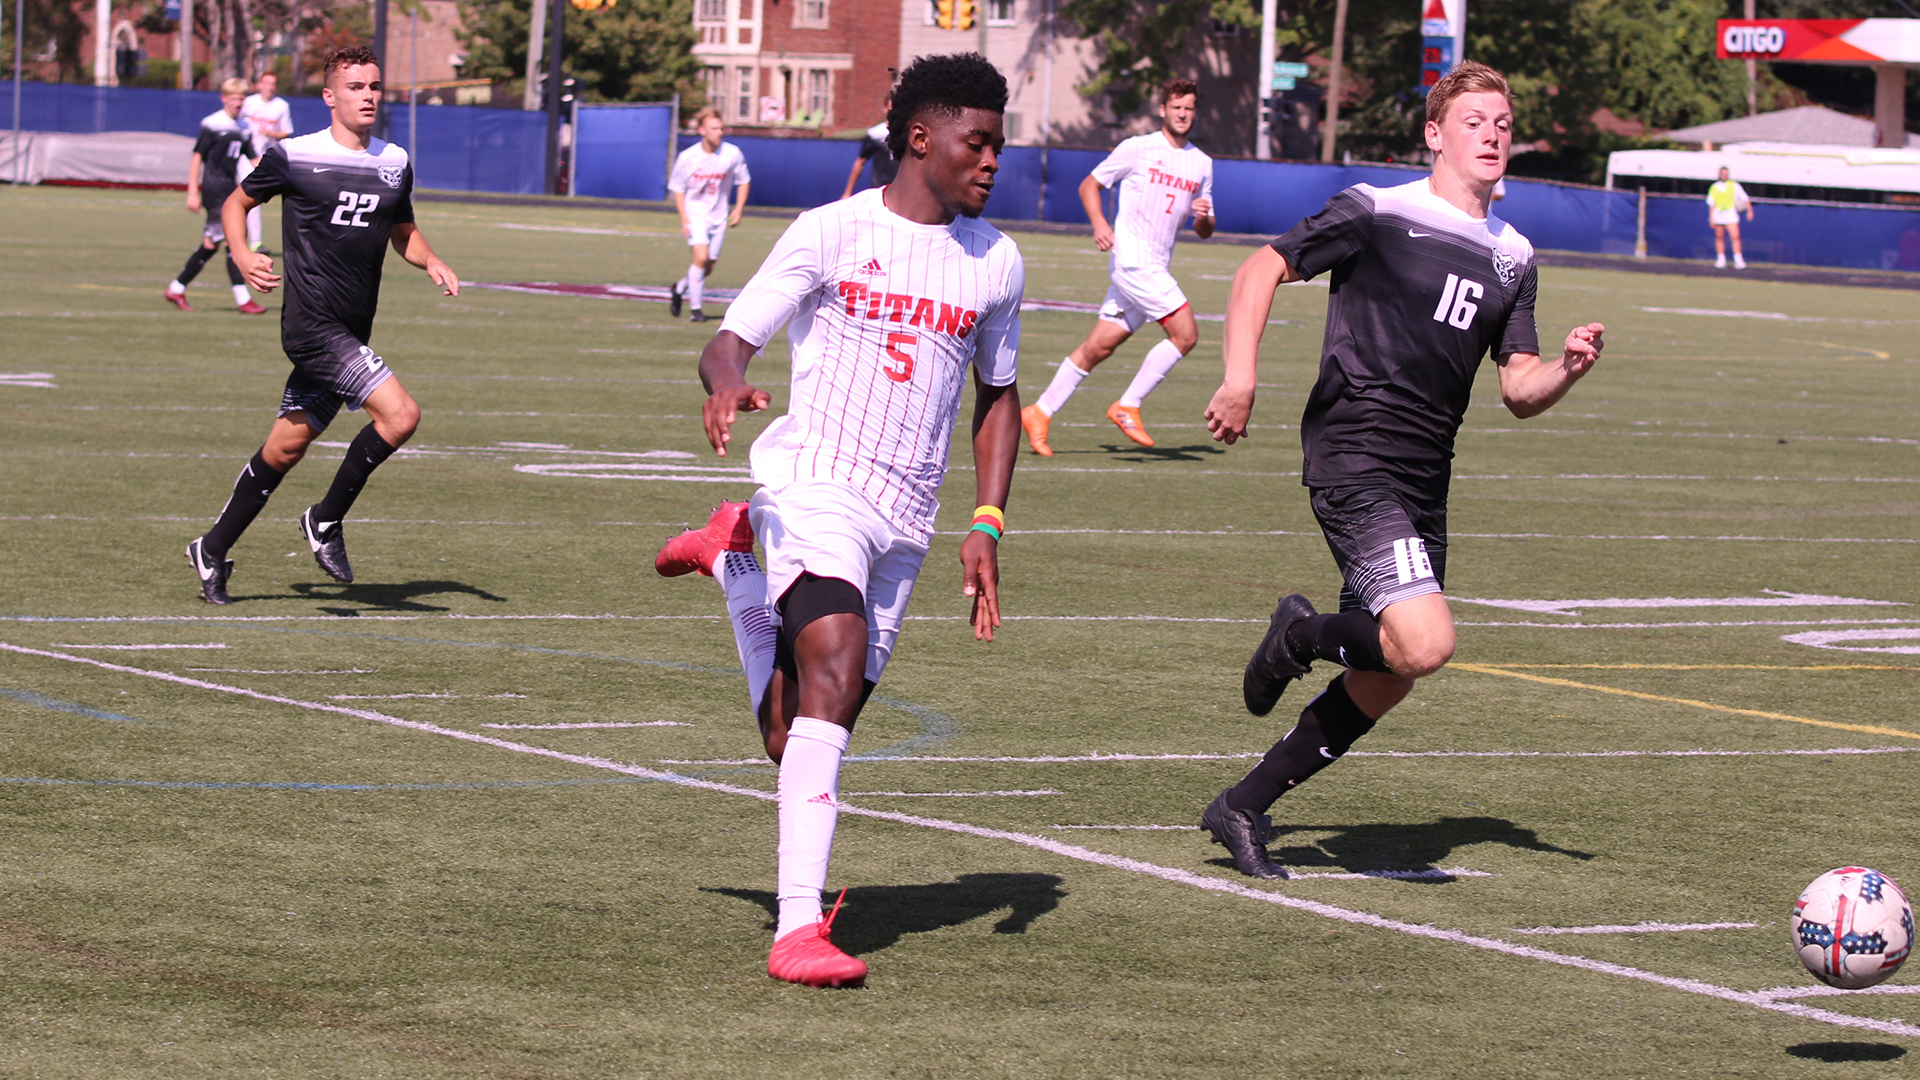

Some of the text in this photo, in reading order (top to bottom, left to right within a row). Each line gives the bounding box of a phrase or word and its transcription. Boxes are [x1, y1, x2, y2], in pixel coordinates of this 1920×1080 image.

[1723, 25, 1787, 53] CITGO
[1148, 167, 1200, 195] TITANS
[330, 190, 380, 228] 22
[1165, 193, 1176, 215] 7
[858, 268, 887, 278] adidas
[839, 280, 978, 339] TITANS
[1433, 272, 1485, 331] 16
[883, 332, 918, 384] 5
[1393, 536, 1435, 585] 16
